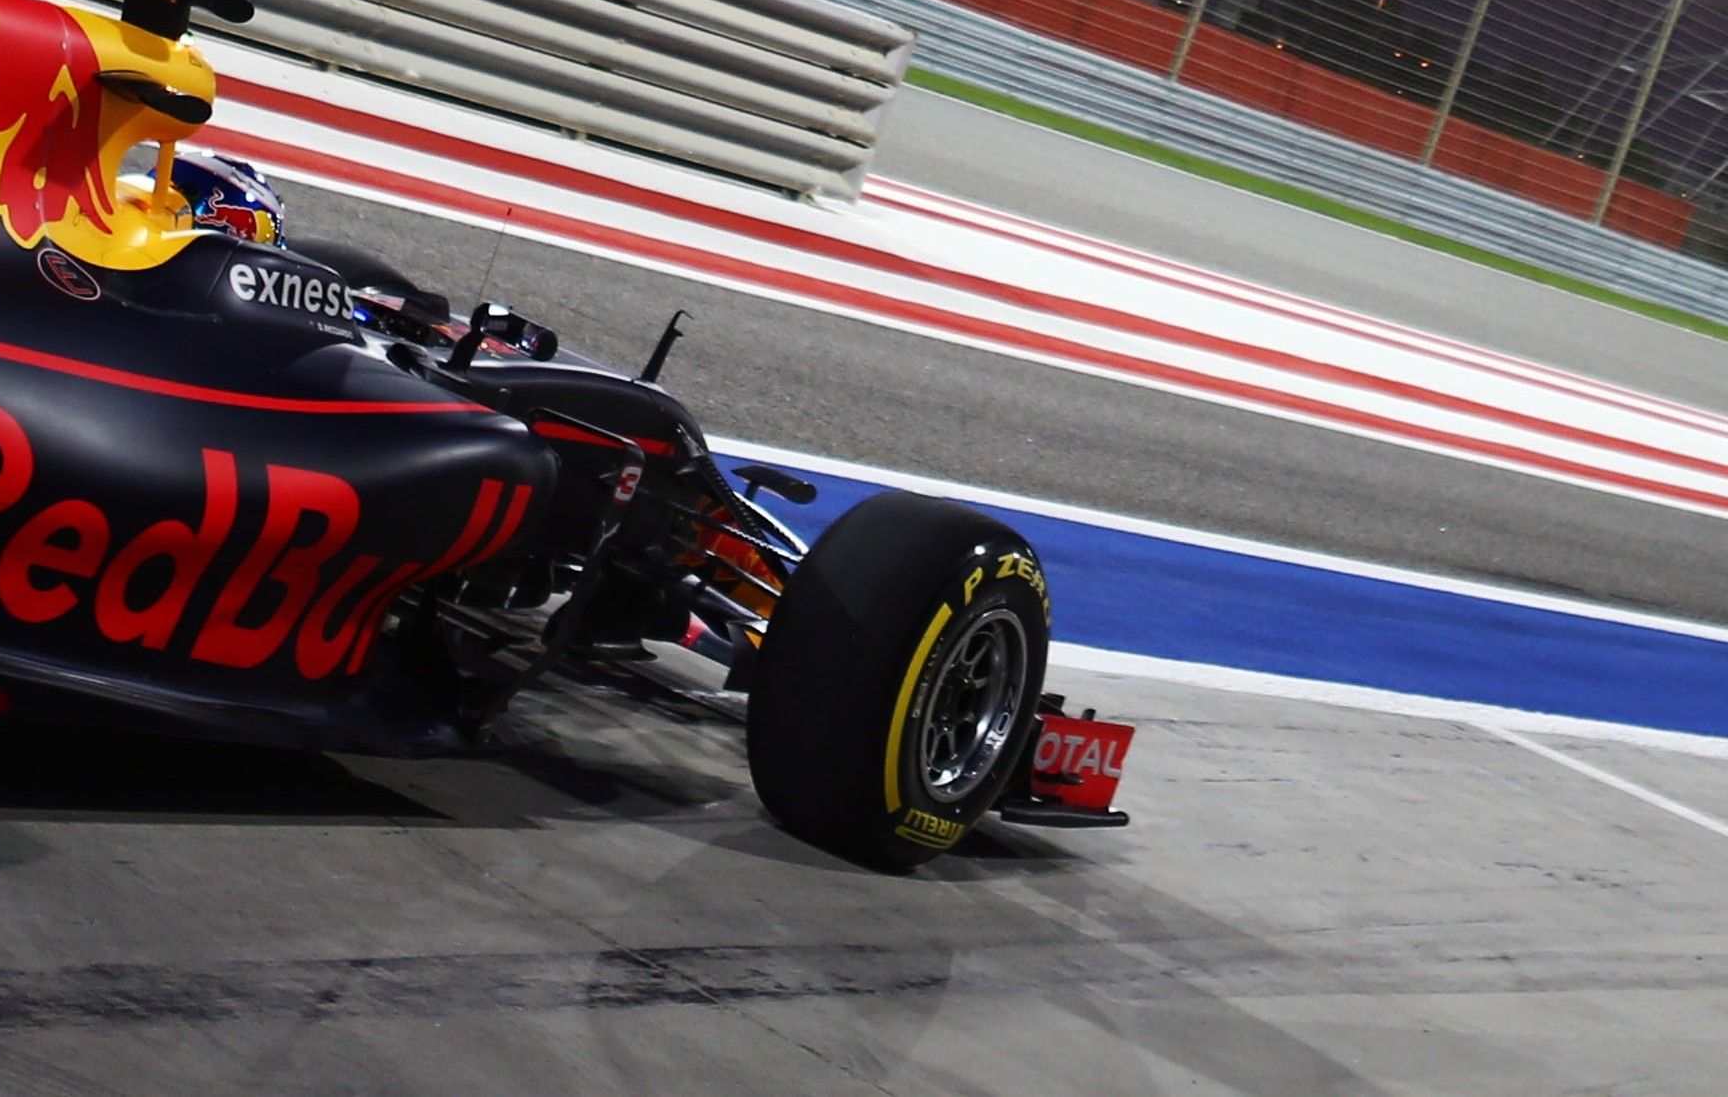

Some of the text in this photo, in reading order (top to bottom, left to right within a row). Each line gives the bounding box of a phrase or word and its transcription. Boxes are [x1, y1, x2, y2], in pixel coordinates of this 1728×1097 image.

[229, 263, 354, 320] exness
[614, 466, 643, 502] 3
[964, 566, 984, 606] P
[1033, 731, 1123, 779] OTAL
